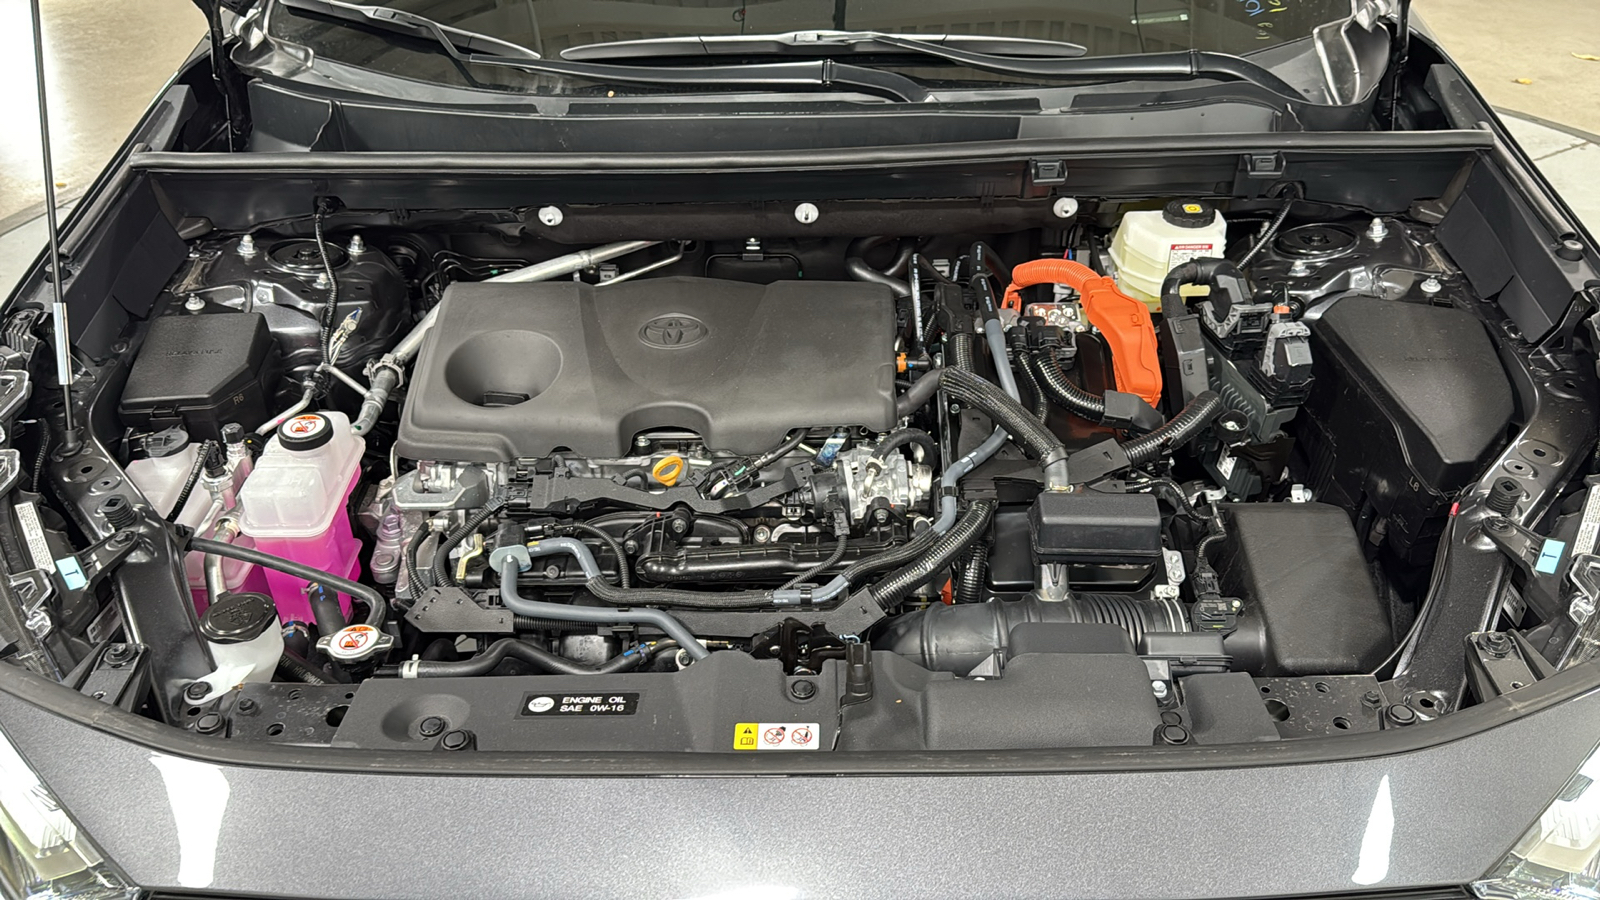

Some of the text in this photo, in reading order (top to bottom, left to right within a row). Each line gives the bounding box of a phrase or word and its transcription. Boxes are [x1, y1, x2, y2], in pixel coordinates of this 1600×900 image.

[232, 393, 245, 405] R6
[562, 696, 626, 704] ENGINE OIL
[559, 704, 624, 712] SAE 0W-16
